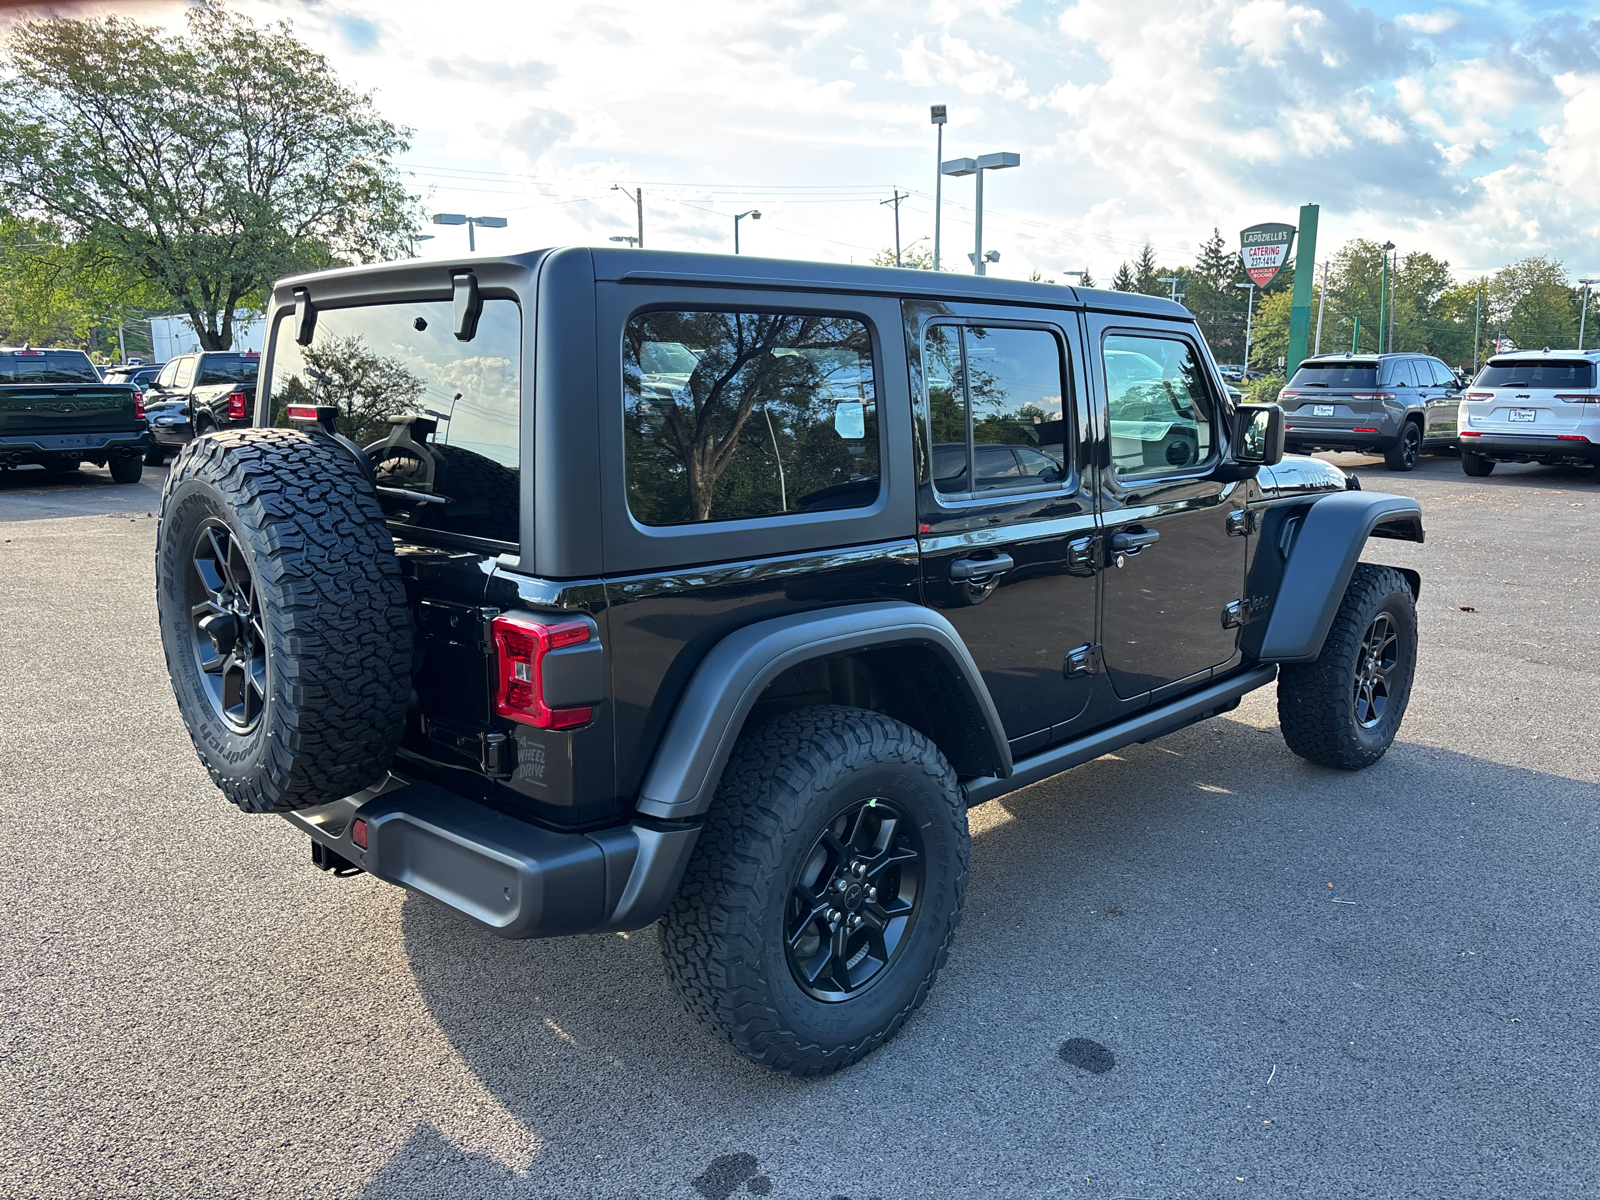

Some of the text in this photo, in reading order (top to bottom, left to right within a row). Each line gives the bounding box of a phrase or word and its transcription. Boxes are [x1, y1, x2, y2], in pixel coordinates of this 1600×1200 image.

[1249, 246, 1280, 257] CATERING
[1251, 256, 1276, 267] 237-1414
[520, 735, 527, 748] 4
[518, 749, 546, 763] WHEEL
[520, 763, 546, 779] DRIVE
